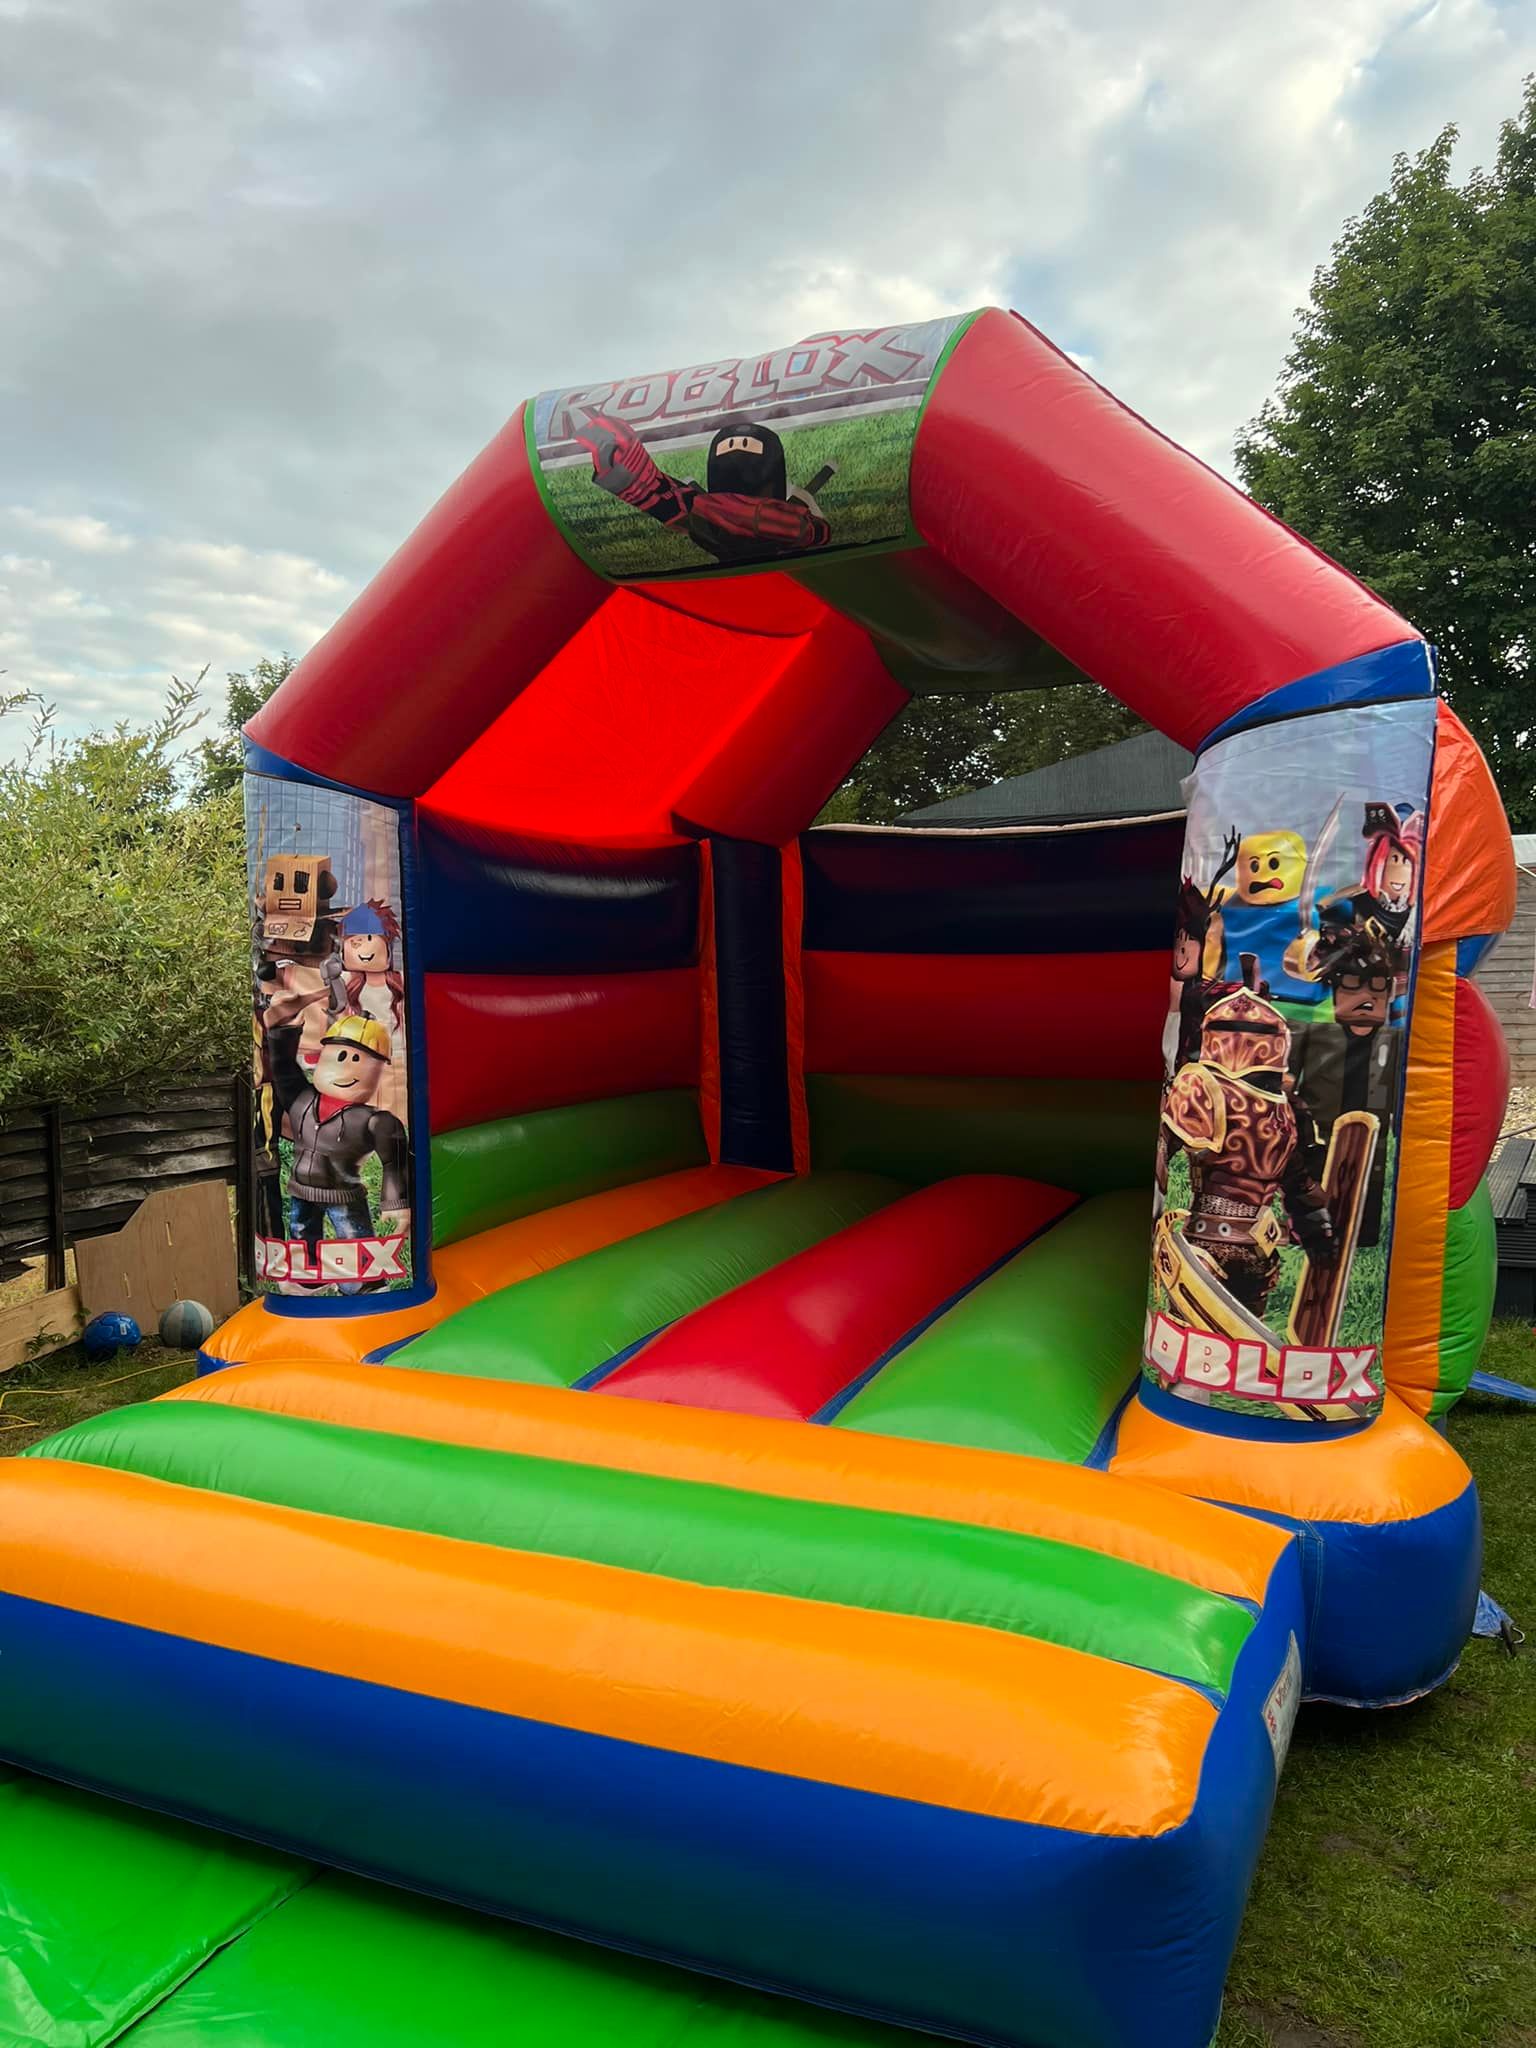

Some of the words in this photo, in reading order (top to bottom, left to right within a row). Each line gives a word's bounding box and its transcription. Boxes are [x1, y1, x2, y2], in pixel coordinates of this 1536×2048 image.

[548, 329, 925, 441] ROBLOX
[255, 1234, 406, 1283] OBLOX
[1144, 1309, 1379, 1402] OBLOX
